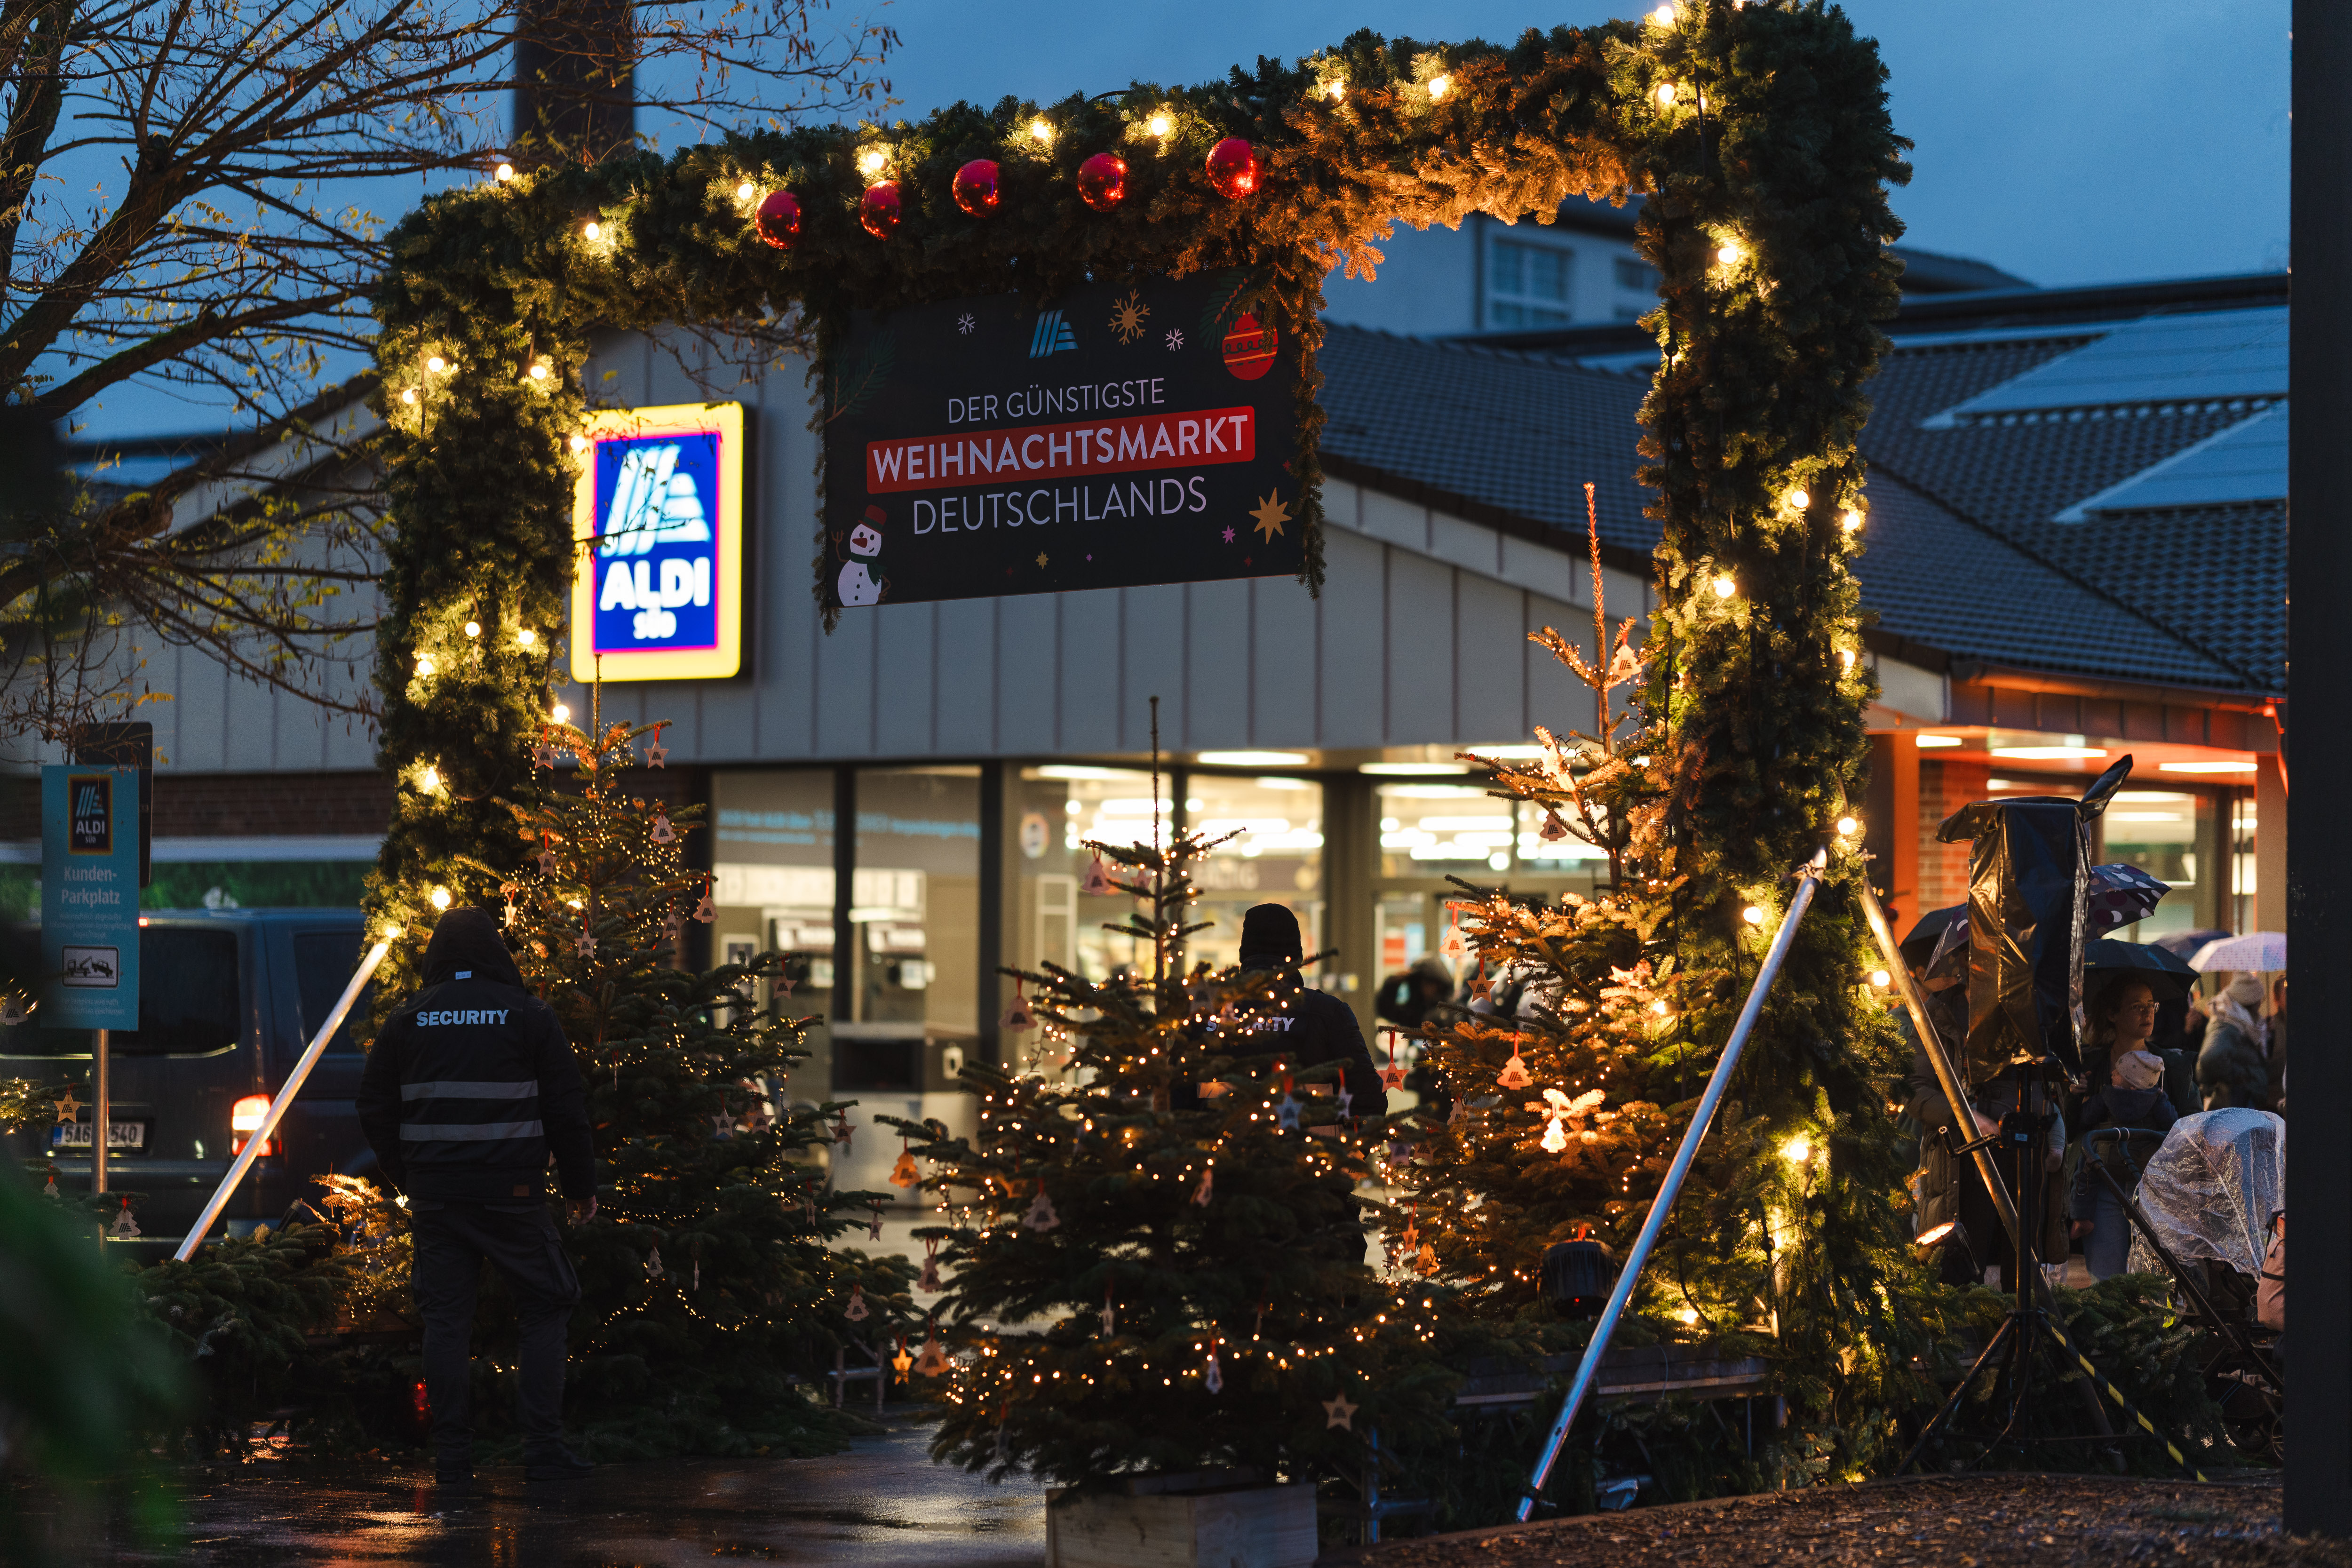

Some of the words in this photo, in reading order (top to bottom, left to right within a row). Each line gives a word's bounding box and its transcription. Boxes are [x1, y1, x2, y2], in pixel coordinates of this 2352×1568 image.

[948, 395, 998, 423] DER
[1007, 378, 1164, 418] GÜNSTIGSTE
[873, 414, 1248, 483] WEIHNACHTSMARKT
[914, 476, 1208, 534] DEUTSCHLANDS
[600, 557, 710, 611] ALDI
[76, 820, 105, 835] ALDI
[85, 835, 96, 844] SÜD
[64, 865, 117, 882] Kunden-
[62, 888, 120, 908] Parkplatz
[416, 1010, 509, 1027] SECURITY
[1206, 1017, 1295, 1031] SRITY
[107, 1126, 137, 1143] 540
